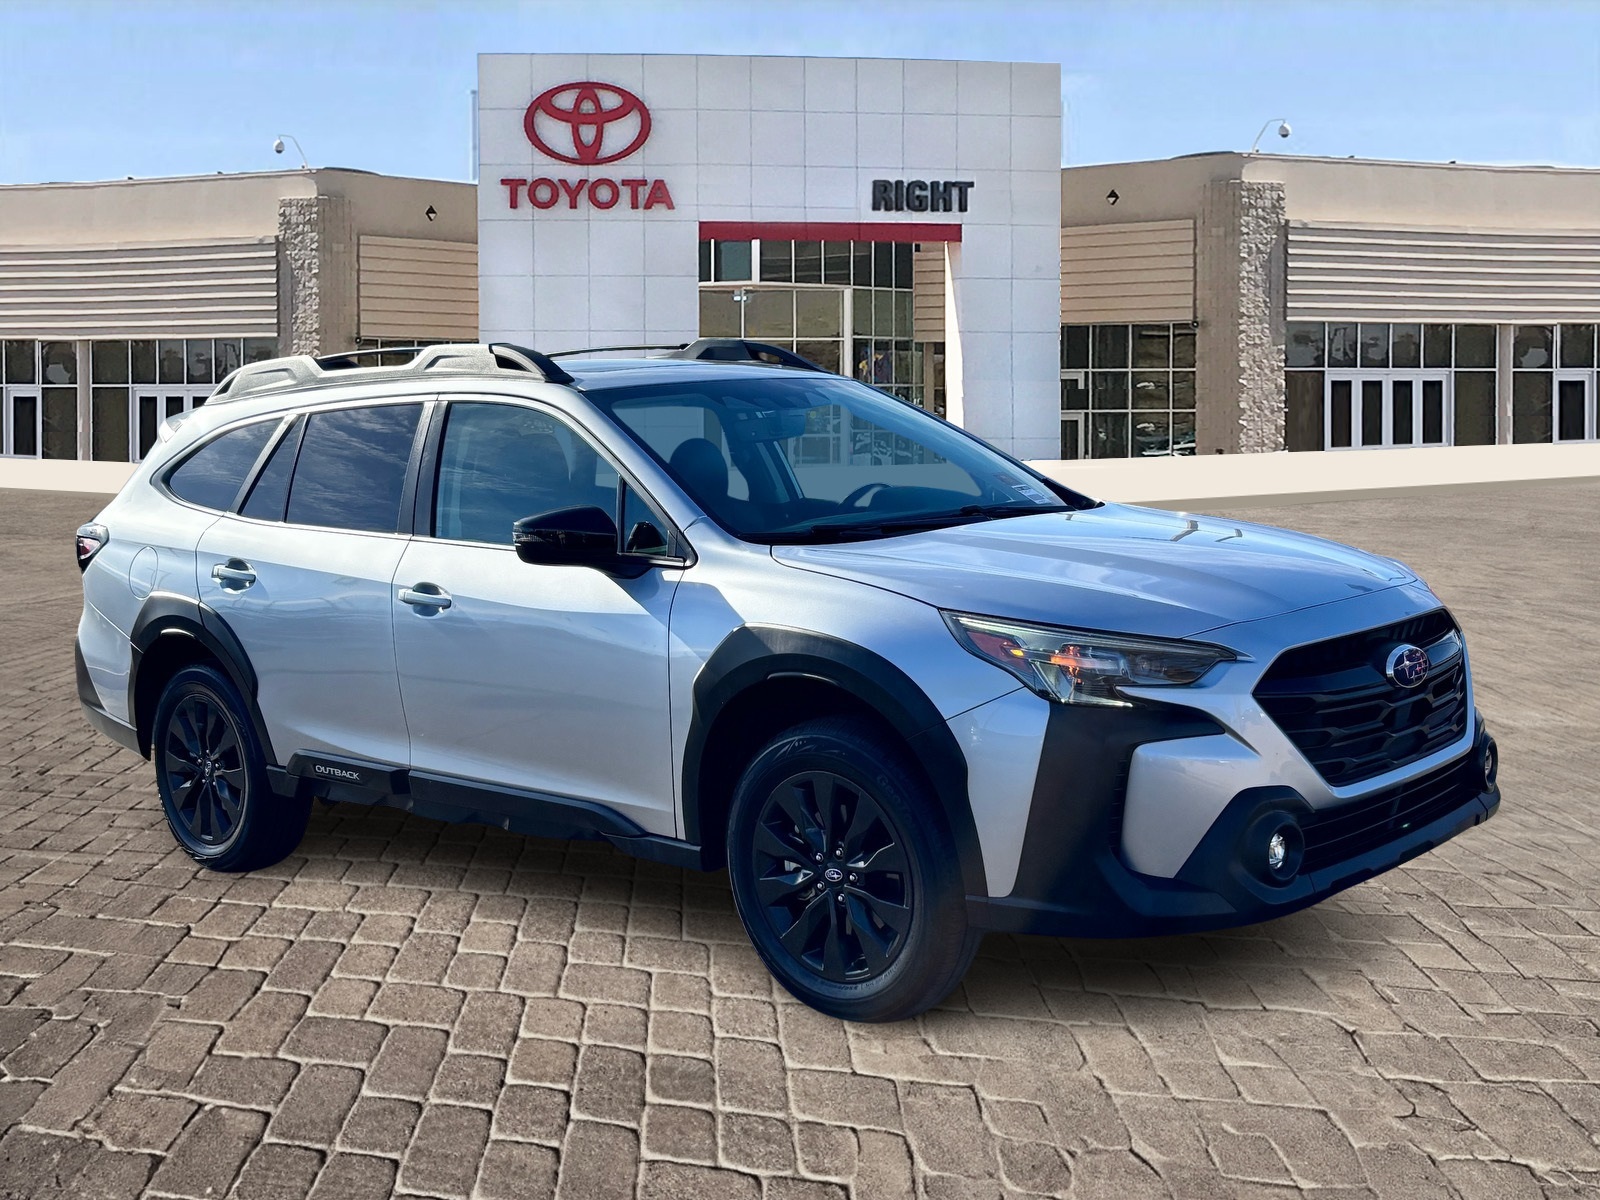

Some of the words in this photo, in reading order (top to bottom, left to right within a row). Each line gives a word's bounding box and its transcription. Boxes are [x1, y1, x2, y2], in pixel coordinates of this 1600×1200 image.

[500, 178, 675, 210] TOYOTA
[872, 179, 975, 212] RIGHT
[315, 764, 360, 780] OUTBACK
